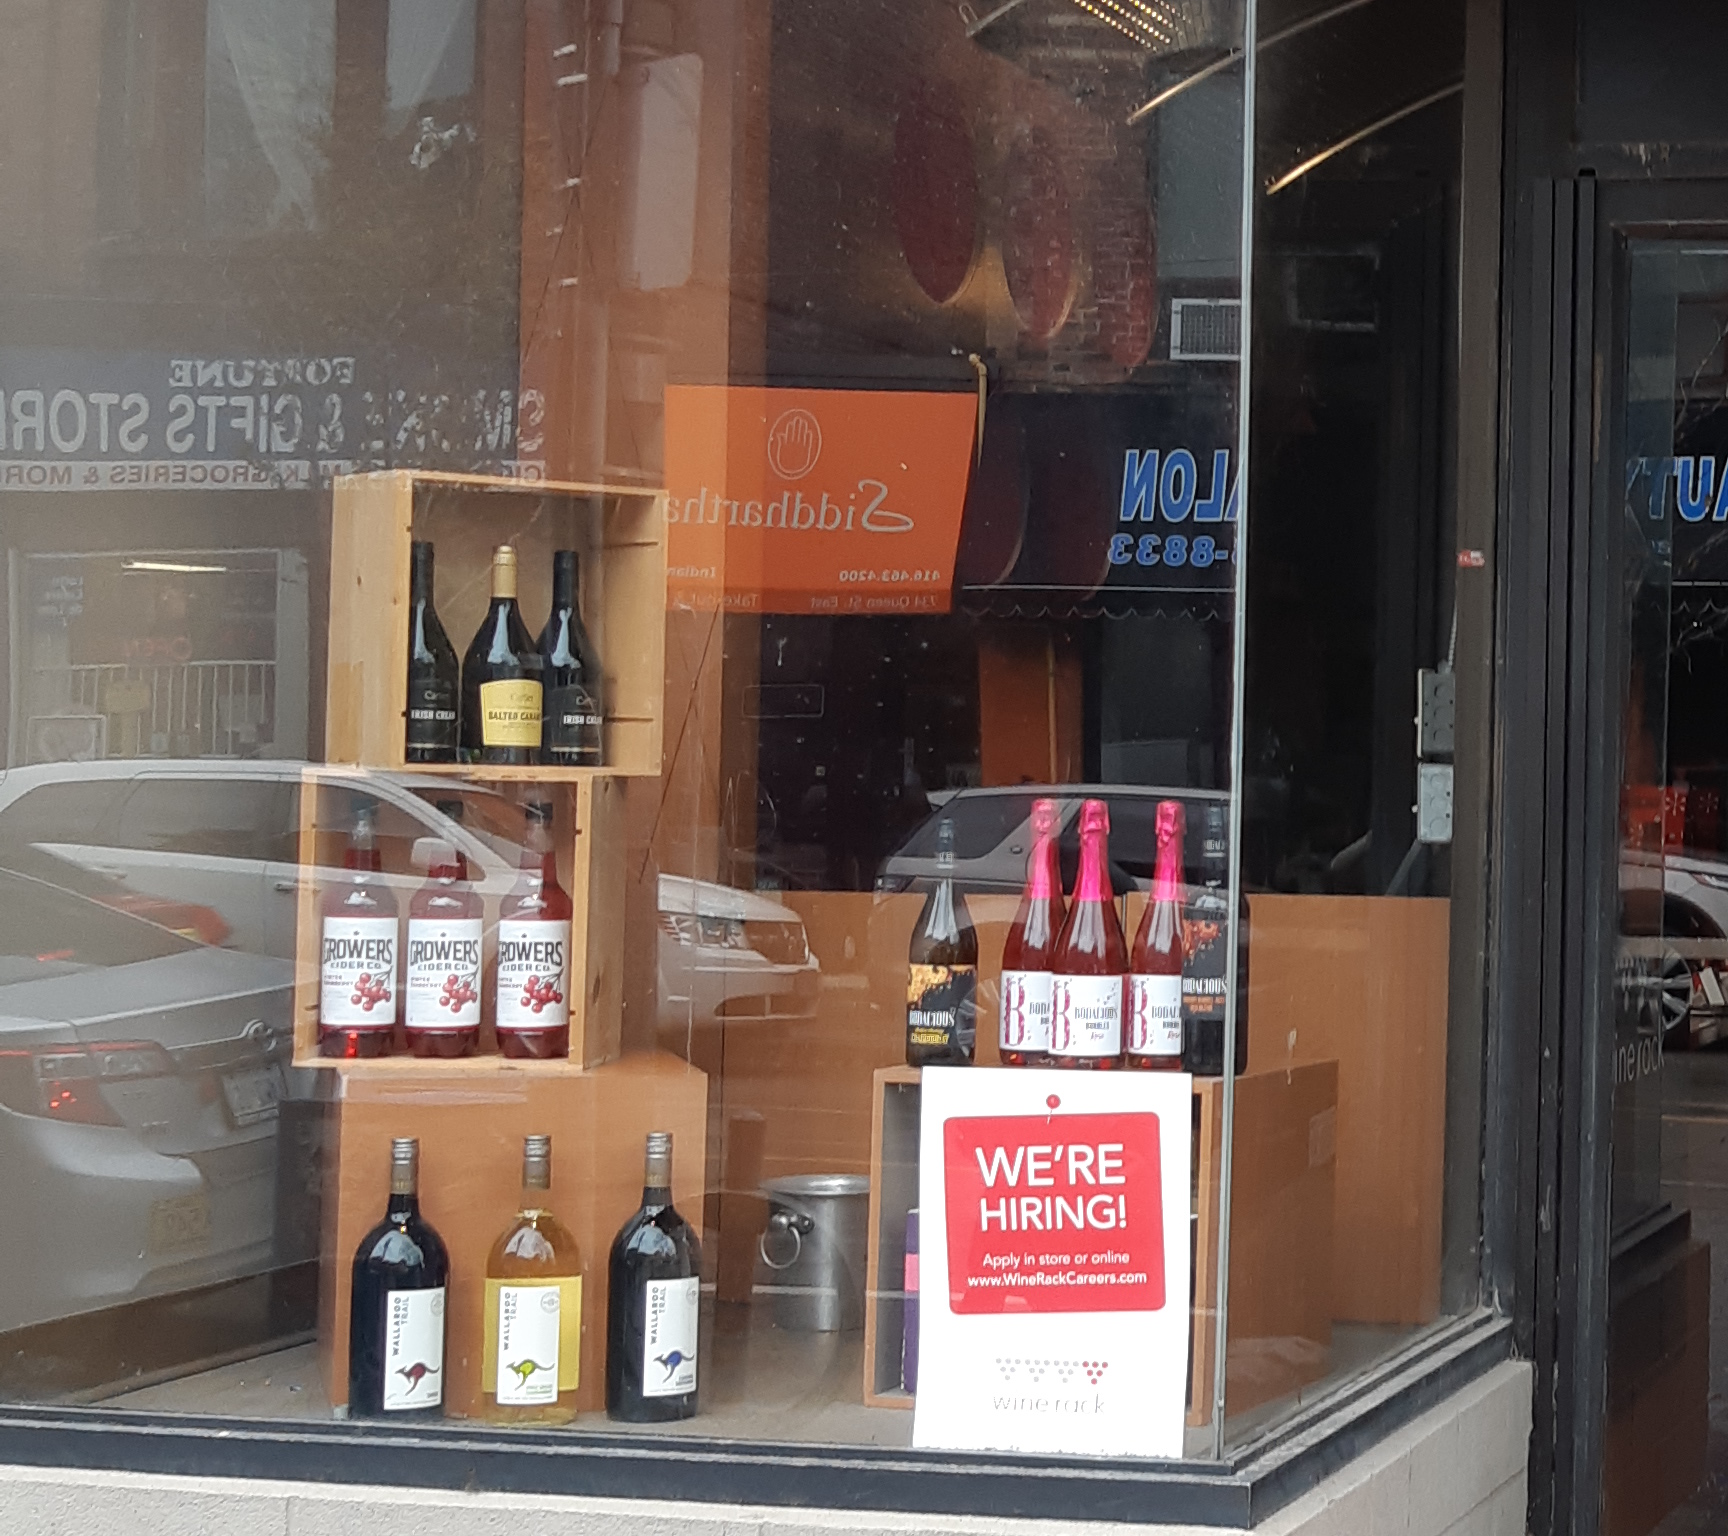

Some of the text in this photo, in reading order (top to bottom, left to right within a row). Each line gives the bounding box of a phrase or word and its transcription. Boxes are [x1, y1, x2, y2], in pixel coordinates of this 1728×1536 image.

[410, 939, 479, 967] GROWERS
[974, 1143, 1126, 1188] WE'RE
[980, 1194, 1128, 1232] HIRING!
[983, 1250, 1130, 1270] Apply in store or online
[967, 1271, 1147, 1288] www.WineRackCareers.com
[992, 1392, 1106, 1415] wine rack
